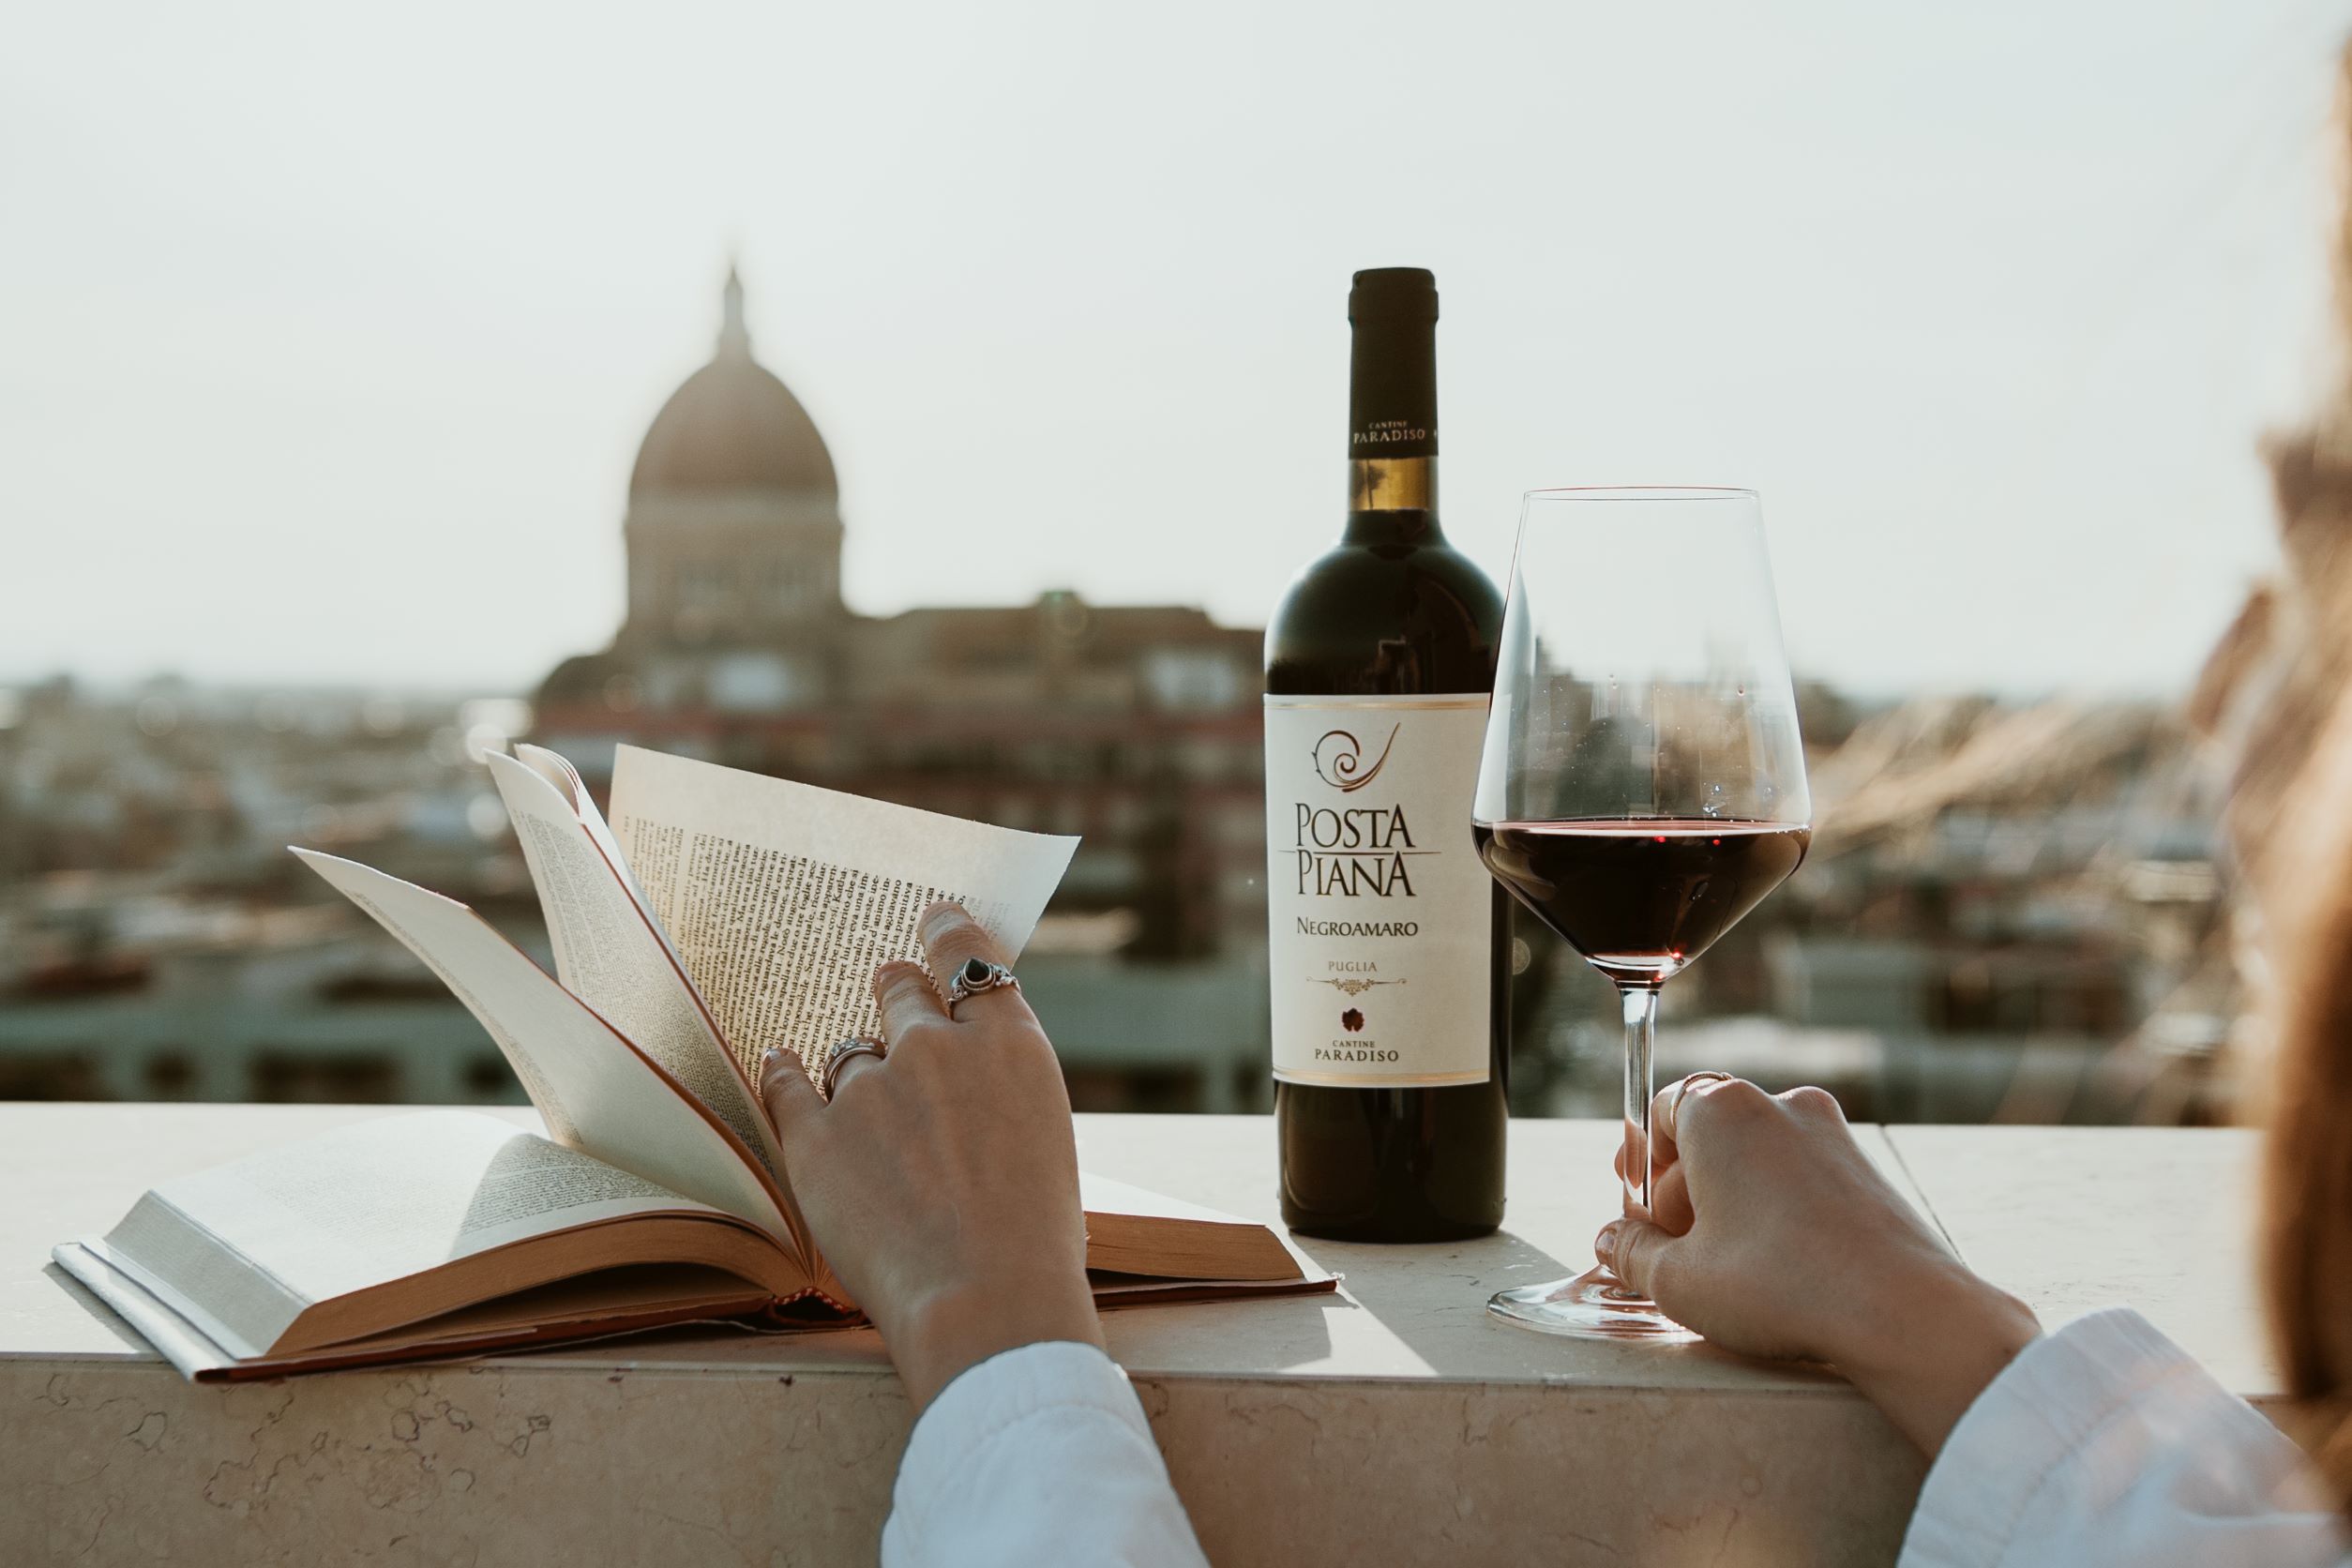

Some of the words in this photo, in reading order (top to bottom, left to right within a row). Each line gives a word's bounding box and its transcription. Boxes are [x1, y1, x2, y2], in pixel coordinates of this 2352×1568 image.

[1353, 429, 1426, 444] PARADISO
[1368, 420, 1408, 430] CANTINE
[1295, 803, 1416, 848] POSTA
[755, 863, 775, 933] sconveniente
[1296, 849, 1417, 897] PIANA
[847, 913, 859, 944] aveva
[883, 879, 901, 930] agitavano
[896, 882, 912, 932] primitiva
[758, 1002, 773, 1048] rapporto
[786, 869, 804, 926] angosciato
[759, 942, 776, 997] riguardava
[773, 1000, 782, 1025] sulla
[779, 969, 791, 999] spalla
[798, 881, 811, 911] foglie
[804, 936, 819, 973] Sedeva
[808, 968, 822, 1005] mentre
[818, 931, 832, 966] taceva
[824, 948, 838, 991] avrebbe
[835, 900, 851, 947] preferito
[835, 1011, 845, 1036] altra
[862, 896, 874, 932] queste
[1328, 961, 1378, 972] PUGLIA
[779, 1008, 791, 1031] loro
[787, 952, 804, 1006] situazione
[853, 968, 867, 1008] proprio
[864, 939, 874, 967] stato
[1315, 1048, 1399, 1062] PARADISO
